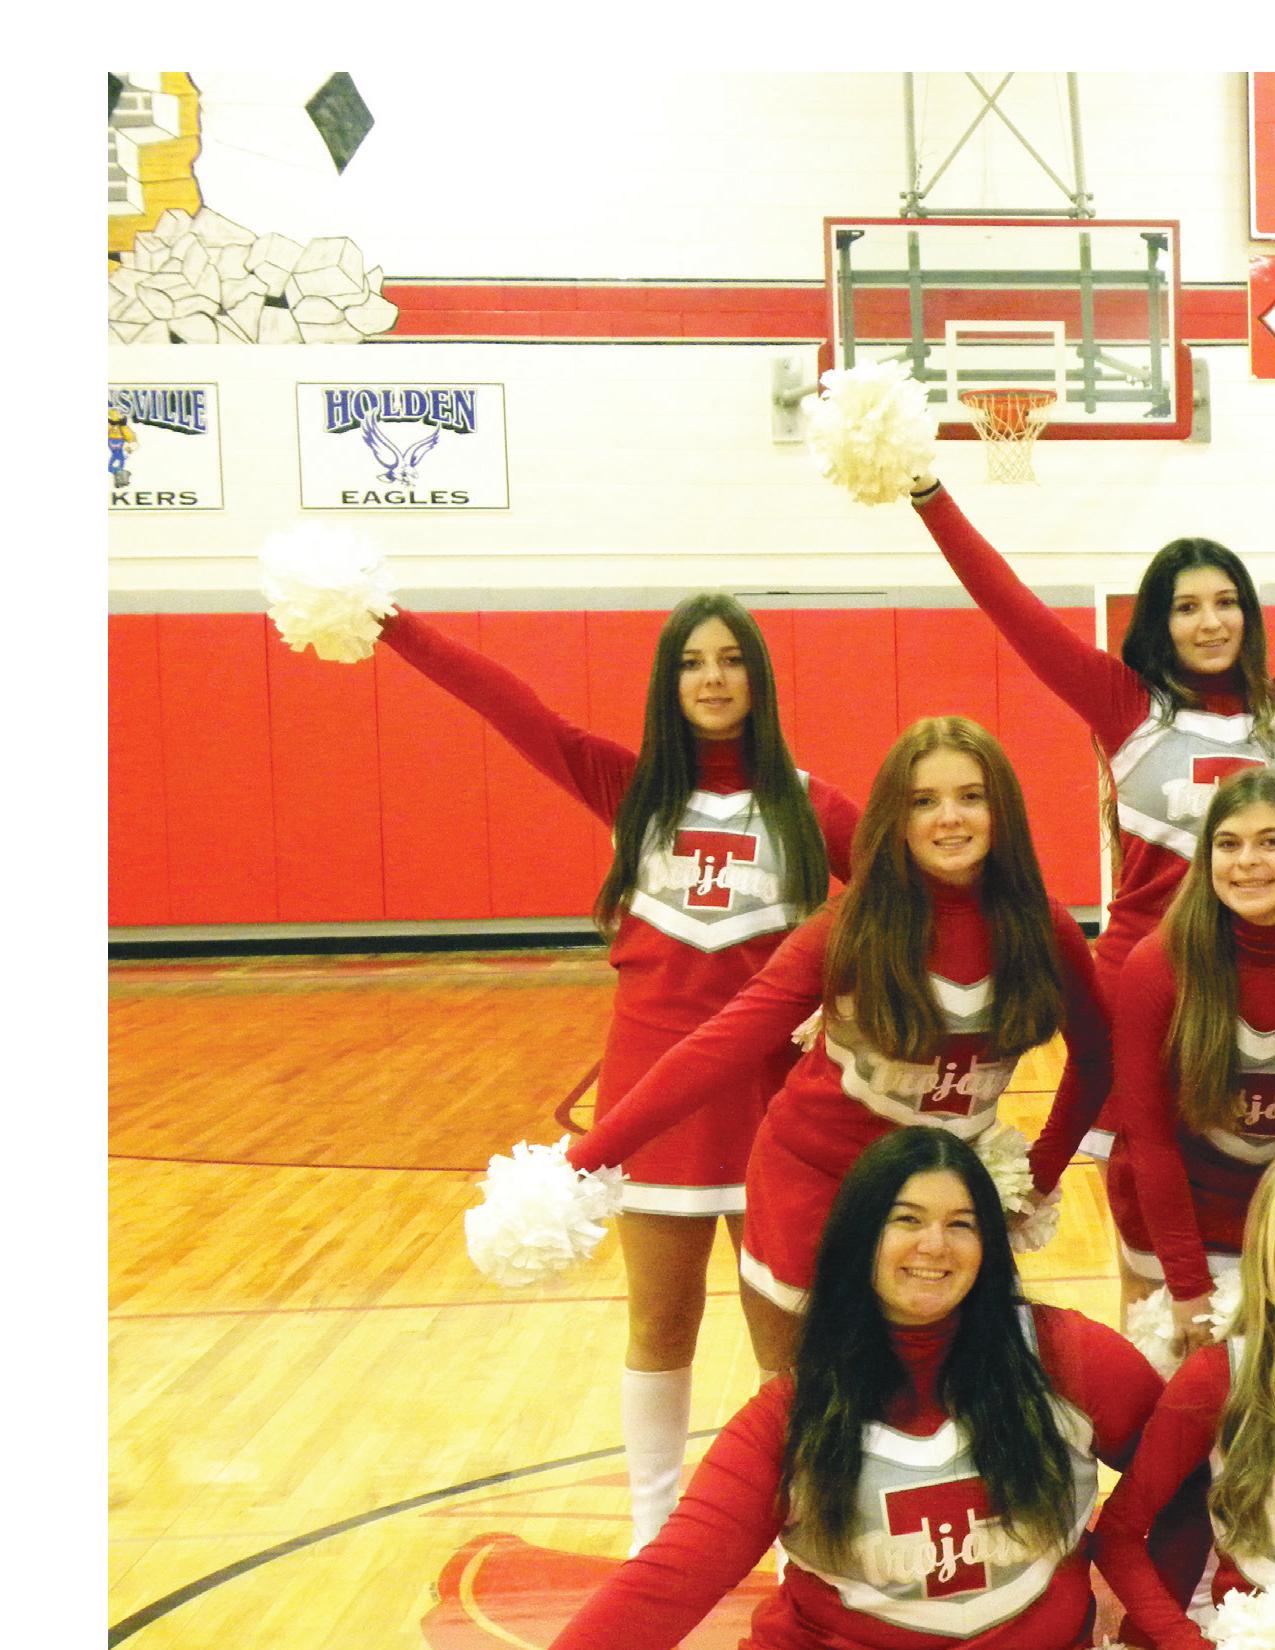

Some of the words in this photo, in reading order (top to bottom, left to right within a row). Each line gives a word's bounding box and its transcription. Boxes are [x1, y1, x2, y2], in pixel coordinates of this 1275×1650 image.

[108, 388, 207, 435] SVILLE
[323, 388, 478, 434] HOLDEN
[112, 491, 198, 506] KERS
[342, 491, 470, 505] EAGLES
